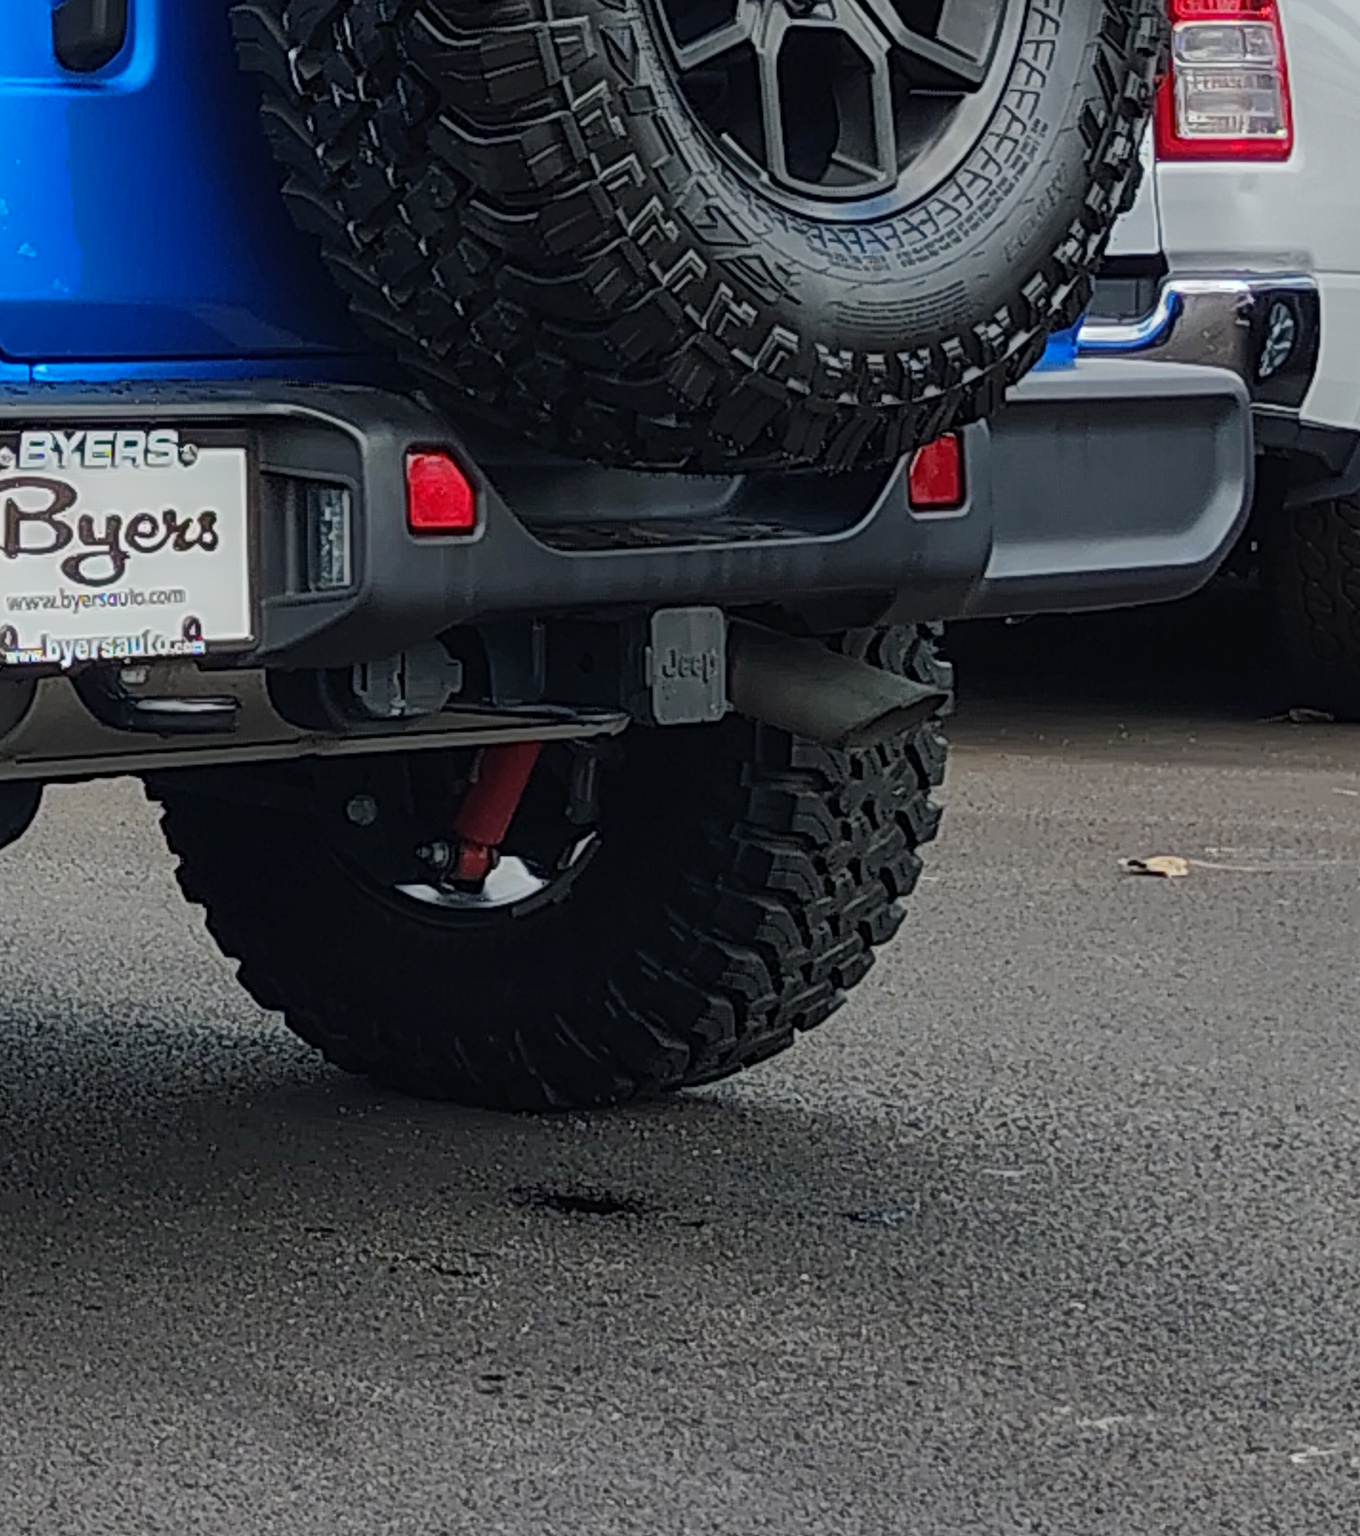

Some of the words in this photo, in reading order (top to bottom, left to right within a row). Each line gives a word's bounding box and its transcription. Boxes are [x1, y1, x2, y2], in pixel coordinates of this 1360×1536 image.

[18, 429, 179, 469] BYERS
[6, 587, 186, 615] www.byersauto.com
[661, 649, 716, 685] Jeep
